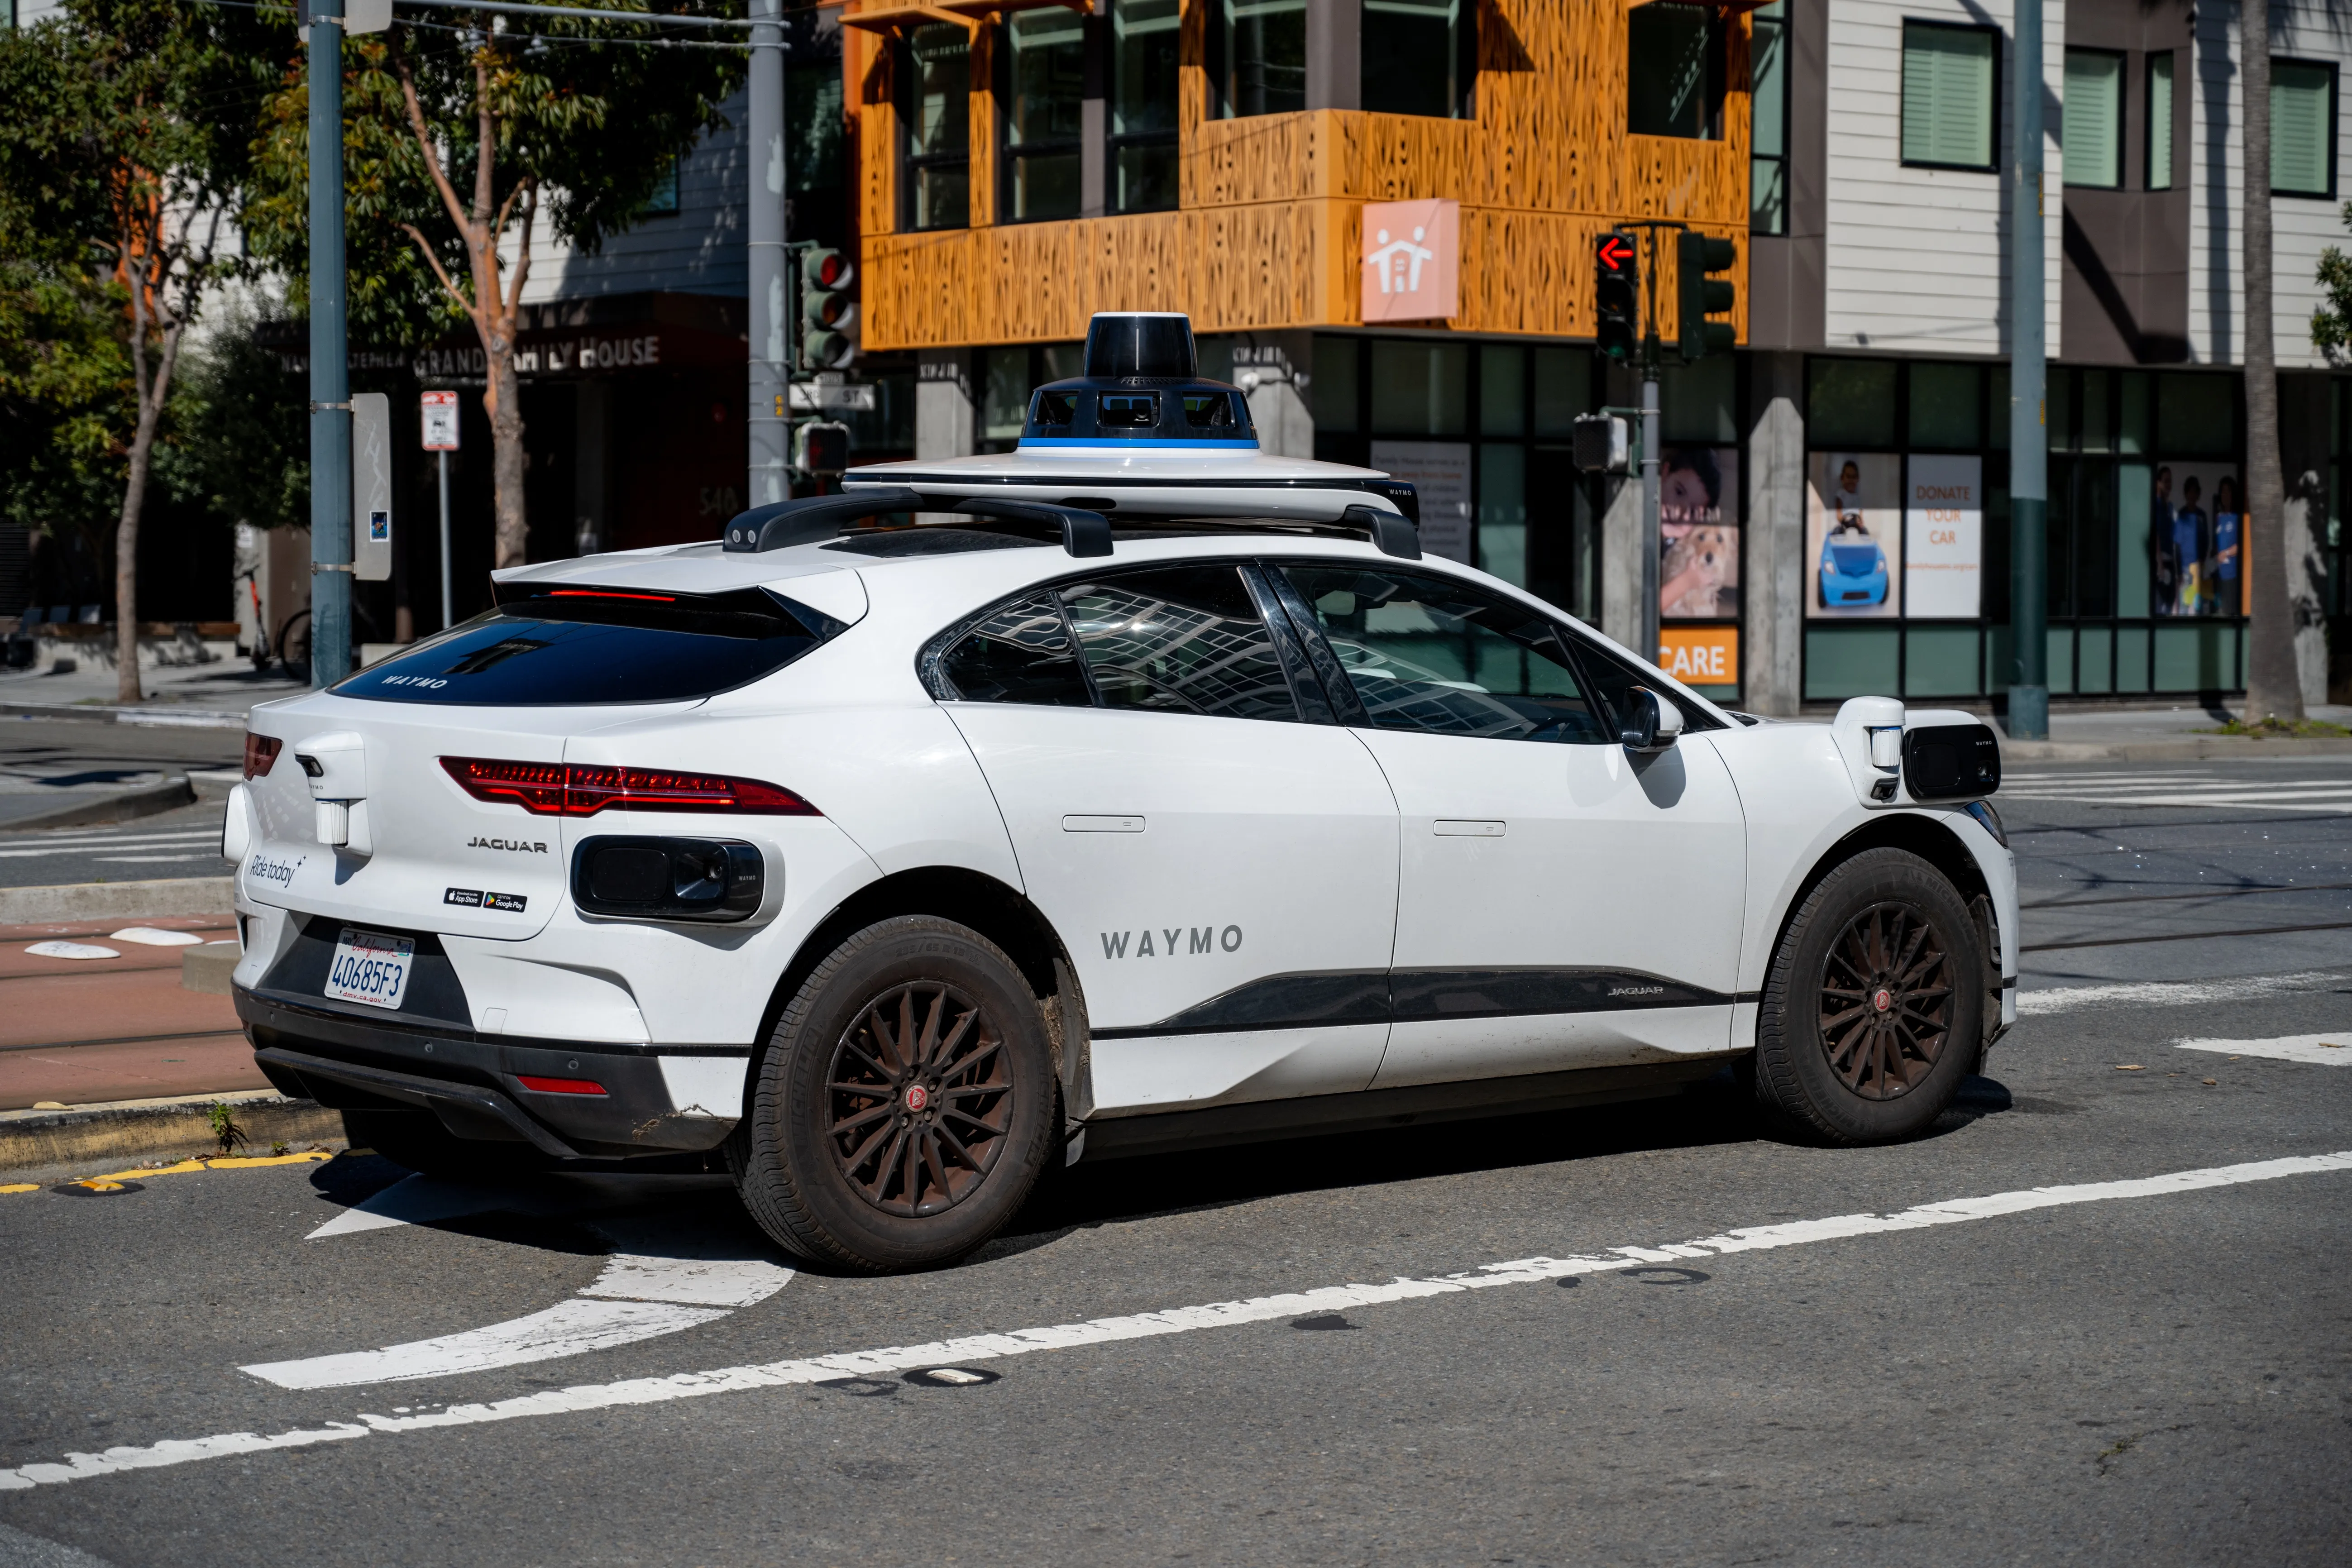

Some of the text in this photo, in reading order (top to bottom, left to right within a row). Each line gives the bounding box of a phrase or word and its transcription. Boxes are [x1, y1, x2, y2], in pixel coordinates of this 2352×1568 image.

[512, 342, 575, 373] AMILY
[579, 336, 660, 370] HOUSE
[842, 389, 860, 404] ST
[698, 486, 739, 516] 540
[1917, 485, 1970, 501] DONATE
[1925, 508, 1961, 522] YOUR
[1929, 530, 1956, 545] CAR
[382, 676, 447, 688] WAYMO
[467, 837, 548, 853] JAGUAR
[250, 854, 295, 888] Ride today
[455, 895, 465, 903] App
[496, 899, 523, 910] Google Play
[1925, 876, 1974, 943] MICHELIN
[342, 936, 353, 946] MAY
[352, 936, 398, 958] California
[1101, 925, 1243, 960] WAYMO
[332, 955, 402, 997] 40685F3
[343, 992, 382, 1003] dmv.ca.gov
[1607, 987, 1664, 996] JAGUAR
[791, 1028, 824, 1150] MICHELIN
